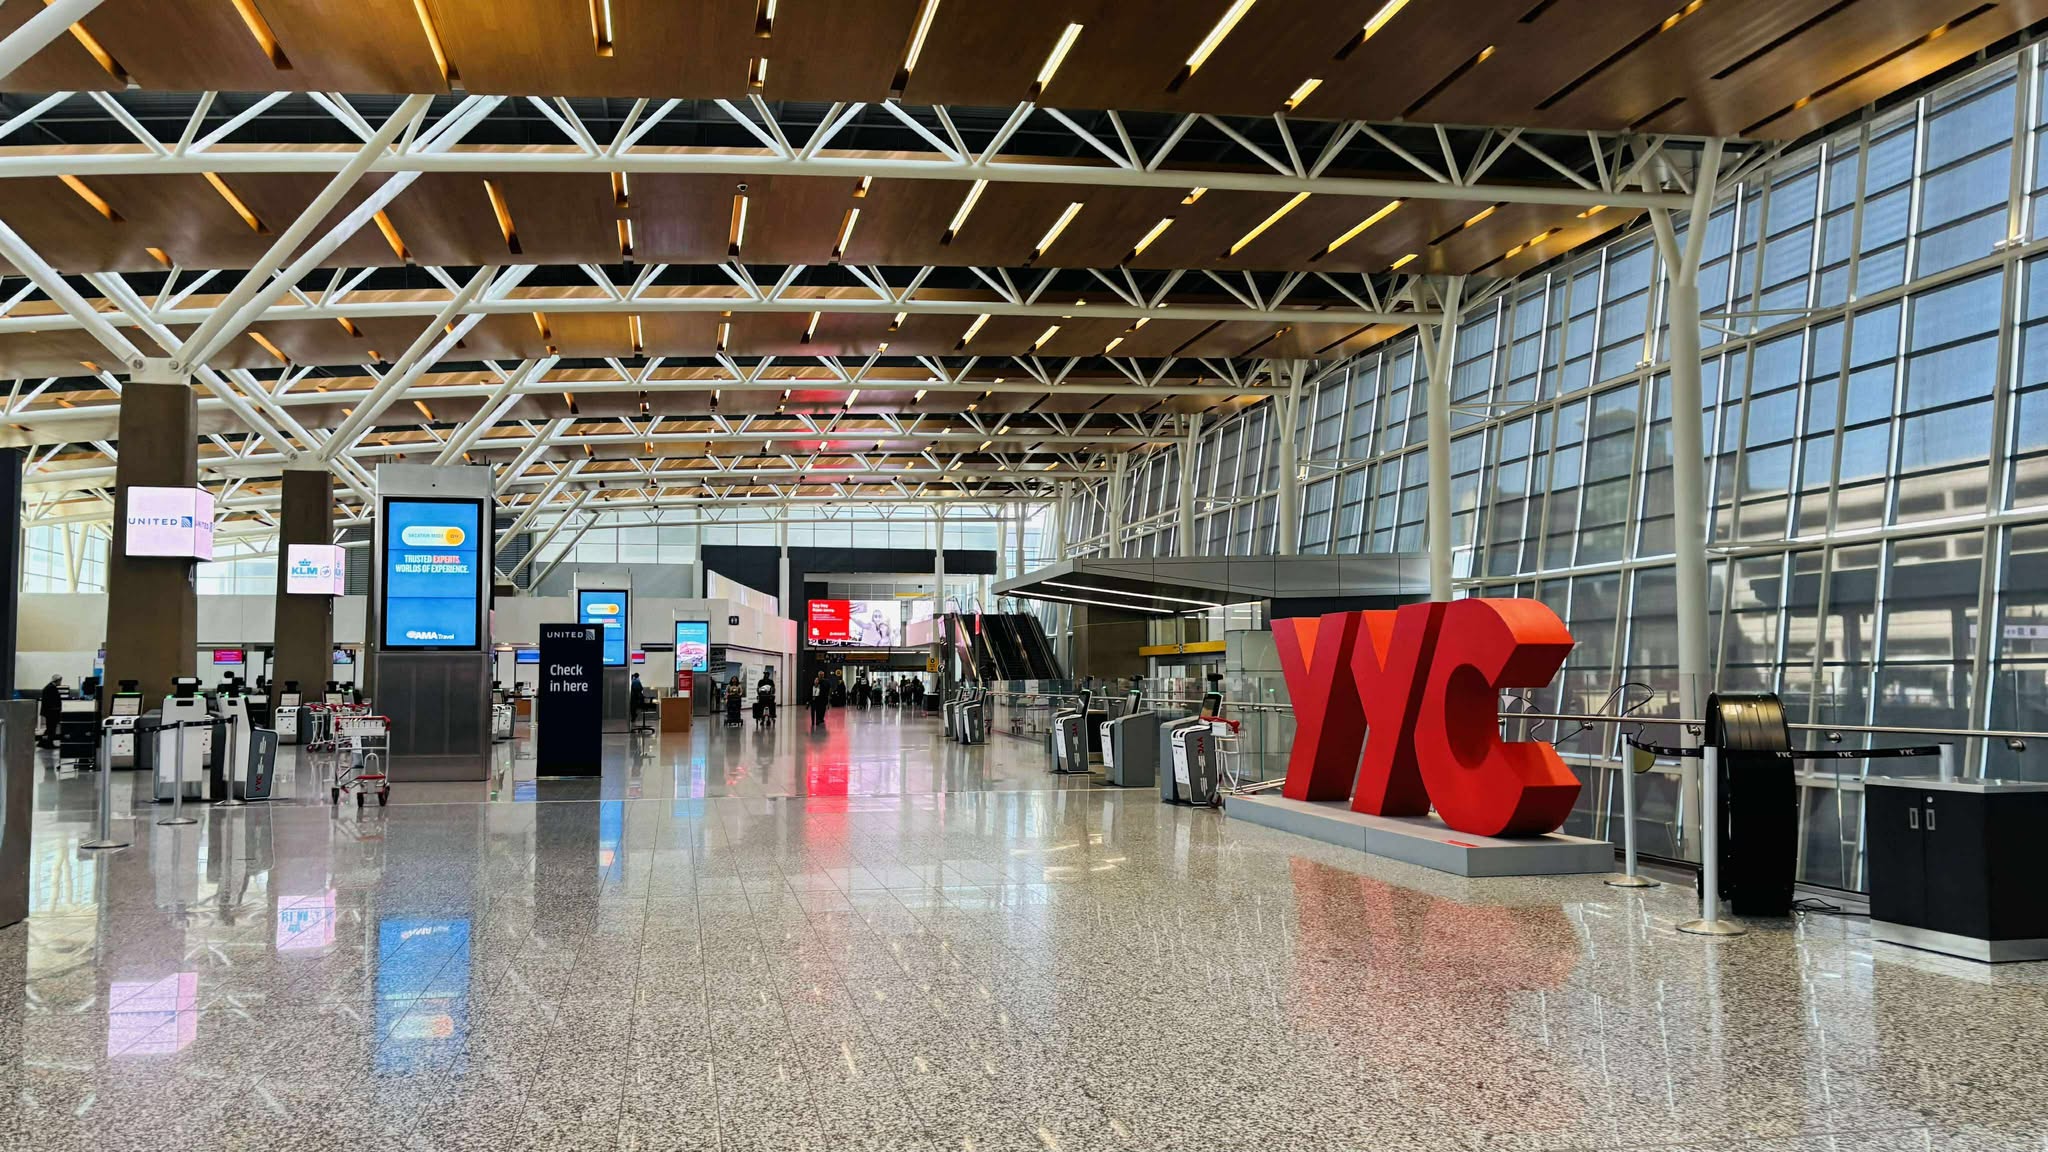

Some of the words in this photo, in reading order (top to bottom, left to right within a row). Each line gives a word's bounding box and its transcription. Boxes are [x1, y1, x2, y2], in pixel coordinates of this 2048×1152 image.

[128, 517, 178, 526] UNITED
[404, 555, 432, 563] TRUSTED
[291, 567, 318, 575] KLM
[395, 564, 421, 572] WORLDS
[422, 564, 431, 572] OF
[188, 564, 194, 588] 4
[414, 631, 438, 640] AMA
[550, 664, 583, 676] Check
[550, 680, 561, 692] in
[563, 680, 589, 692] here
[1270, 597, 1582, 837] YYC
[1899, 748, 1915, 756] YYC
